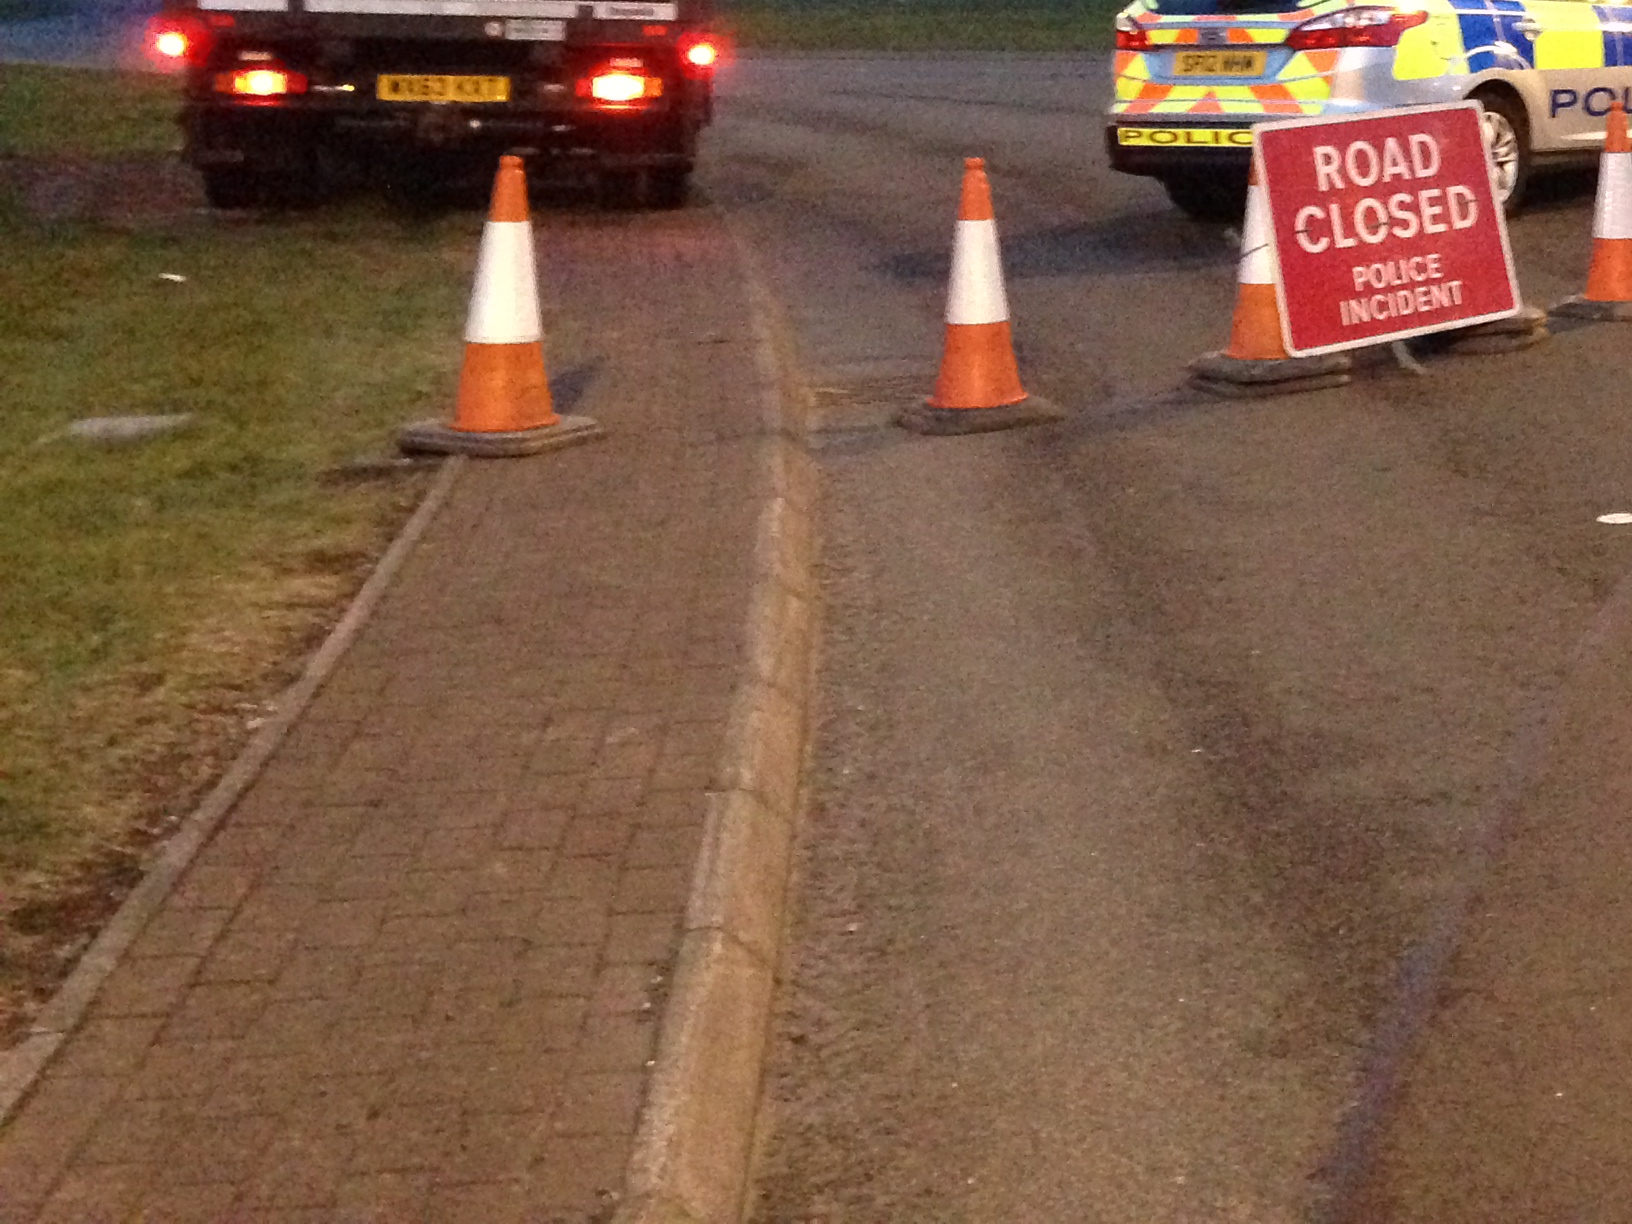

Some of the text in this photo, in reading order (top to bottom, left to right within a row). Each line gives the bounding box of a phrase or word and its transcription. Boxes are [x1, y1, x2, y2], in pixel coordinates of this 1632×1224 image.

[1125, 129, 1253, 145] POLIC
[1312, 133, 1442, 192] ROAD
[1294, 185, 1479, 254] CLOSED
[1352, 253, 1444, 291] POLICE
[1339, 280, 1463, 326] INCIDENT
